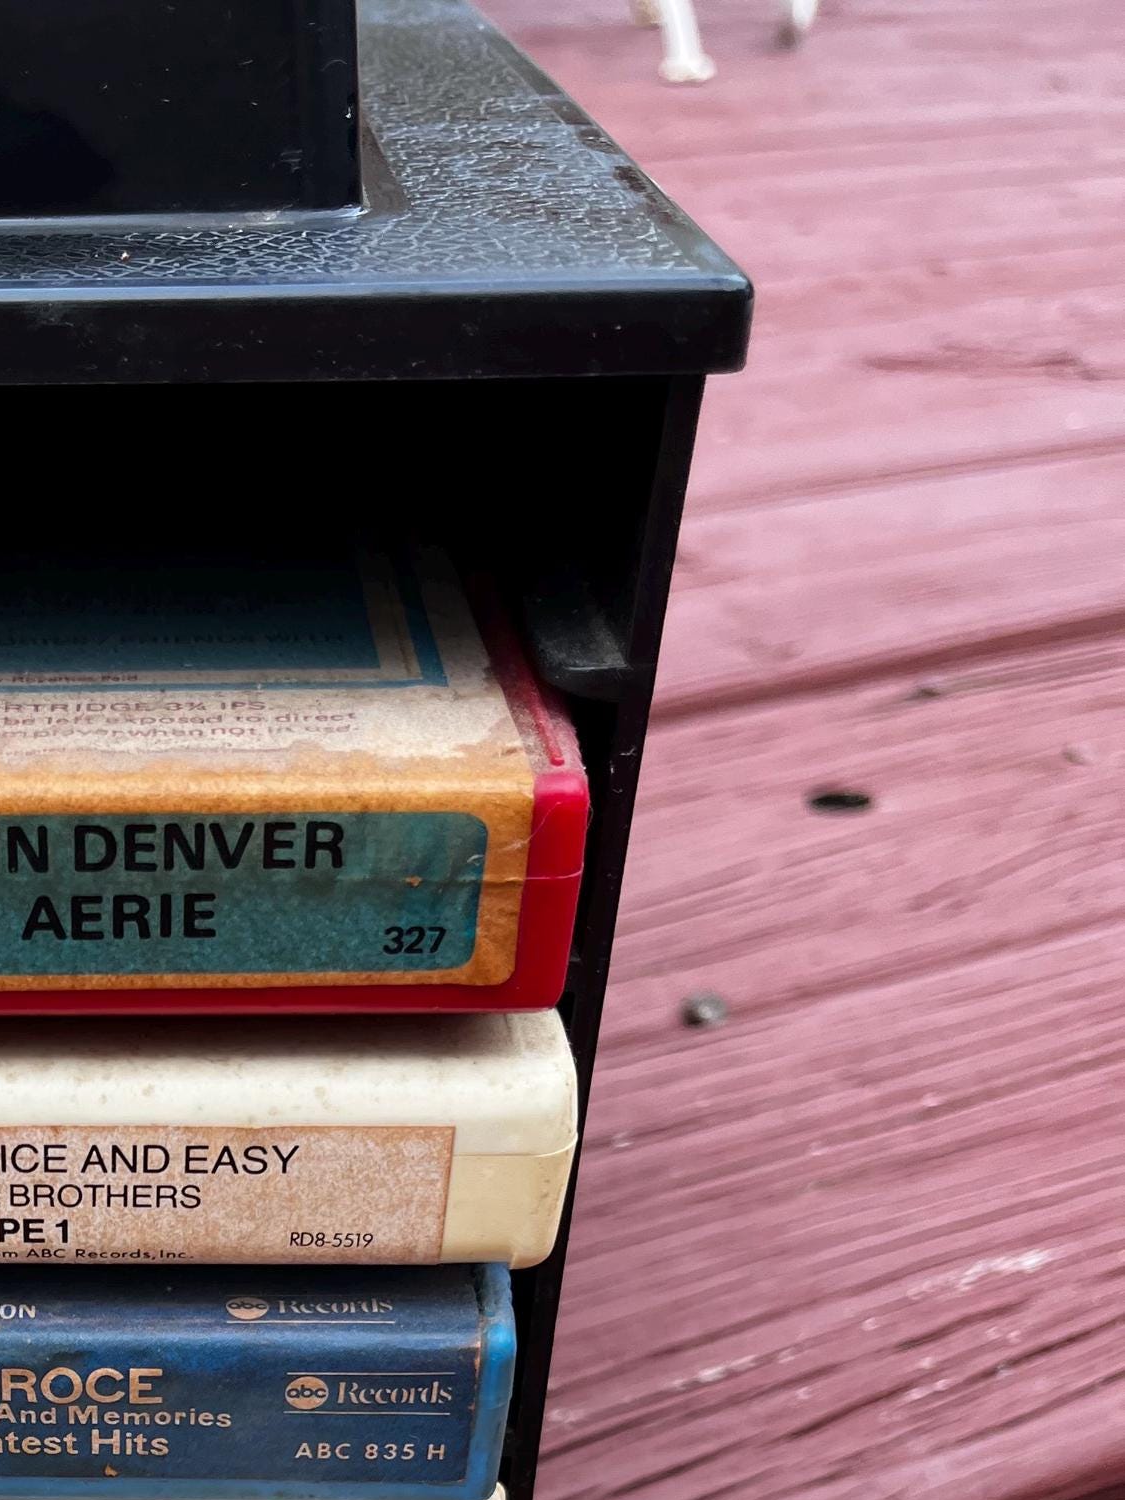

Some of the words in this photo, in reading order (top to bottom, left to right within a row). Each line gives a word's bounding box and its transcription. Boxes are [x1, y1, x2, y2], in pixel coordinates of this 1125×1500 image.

[2, 716, 37, 727] be
[47, 715, 94, 726] left
[104, 713, 224, 727] exposed
[235, 715, 266, 723] to
[275, 711, 357, 723] direct
[125, 726, 205, 738] when
[210, 726, 258, 737] not
[73, 819, 345, 873] DENVER
[21, 892, 217, 941] AERIE
[382, 926, 448, 955] 327
[80, 1143, 171, 1175] AND
[183, 1144, 300, 1176] EASY
[10, 1184, 202, 1209] BROTHERS
[54, 1218, 70, 1244] 1
[288, 1231, 374, 1249] RD8-5519
[26, 1247, 67, 1260] ABC
[278, 1299, 394, 1315] Records
[285, 1384, 328, 1400] abc
[336, 1380, 454, 1406] Records
[67, 1405, 233, 1428] Memories
[90, 1429, 171, 1457] Hits
[294, 1442, 352, 1461] ABC
[363, 1442, 416, 1461] 835
[427, 1443, 446, 1461] H
